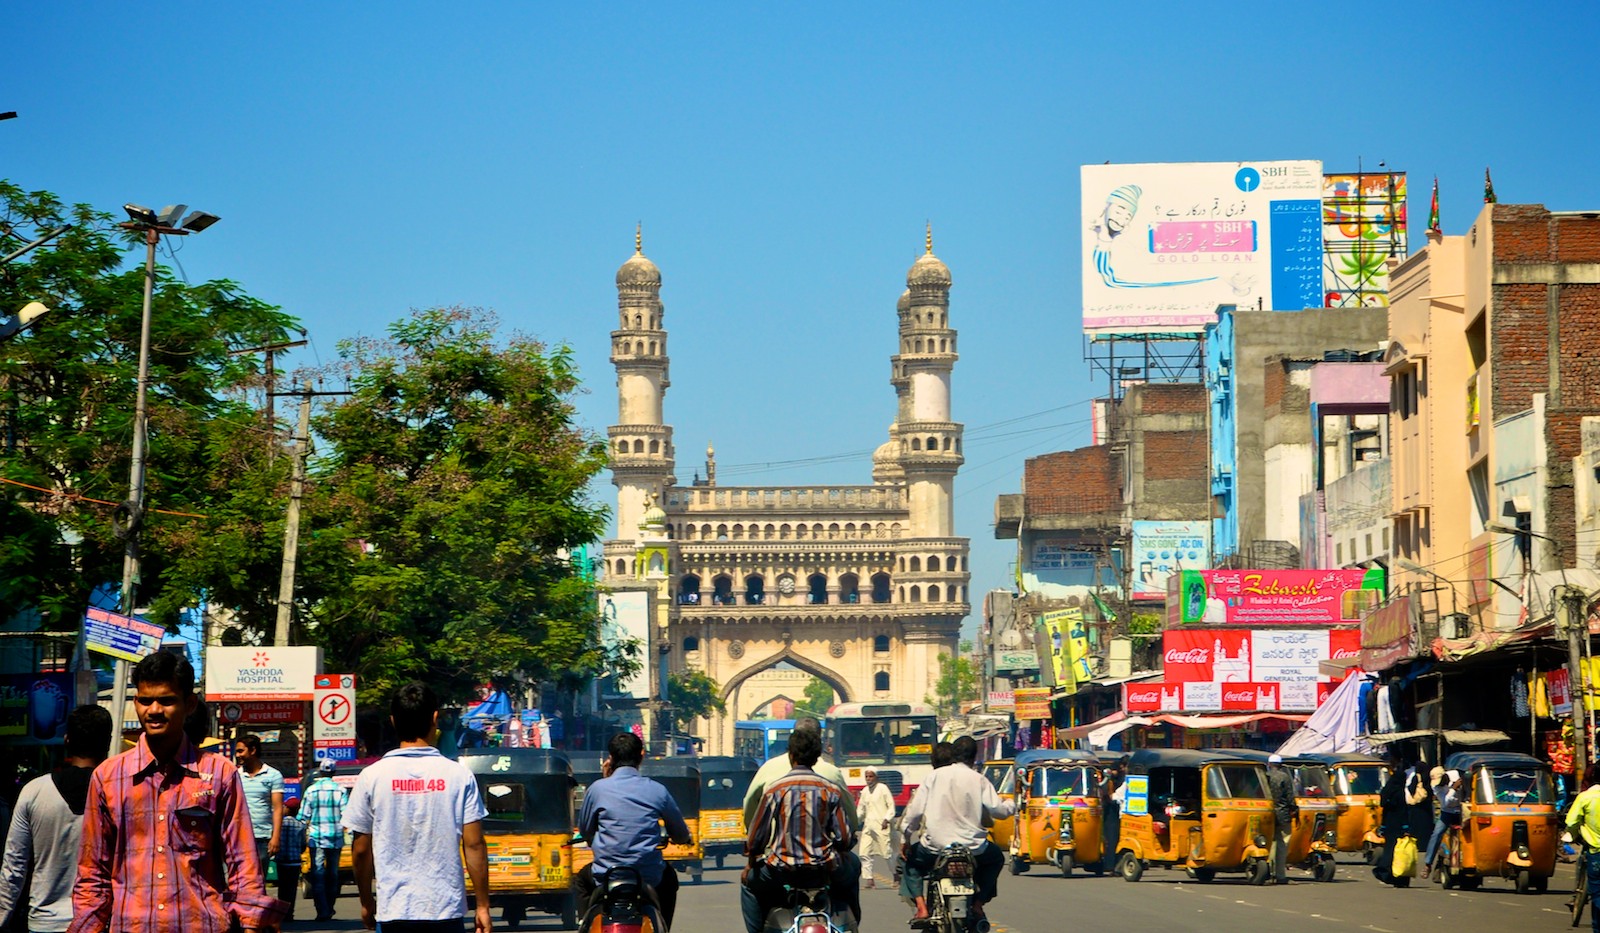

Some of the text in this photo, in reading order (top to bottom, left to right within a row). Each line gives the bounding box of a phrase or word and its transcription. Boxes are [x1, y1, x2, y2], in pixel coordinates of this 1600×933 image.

[1262, 166, 1288, 177] SBH
[1213, 221, 1242, 233] SBH
[1157, 253, 1253, 263] GOLD LOAN
[1140, 540, 1156, 548] SMS
[1181, 540, 1191, 548] AC
[1292, 596, 1335, 608] Collection
[1165, 648, 1210, 663] Coca-Cola
[238, 668, 284, 676] YASHODA
[236, 676, 284, 684] HOSPITAL
[989, 692, 1014, 700] TIMES
[328, 748, 352, 758] SBH
[392, 779, 446, 791] PUMA 48
